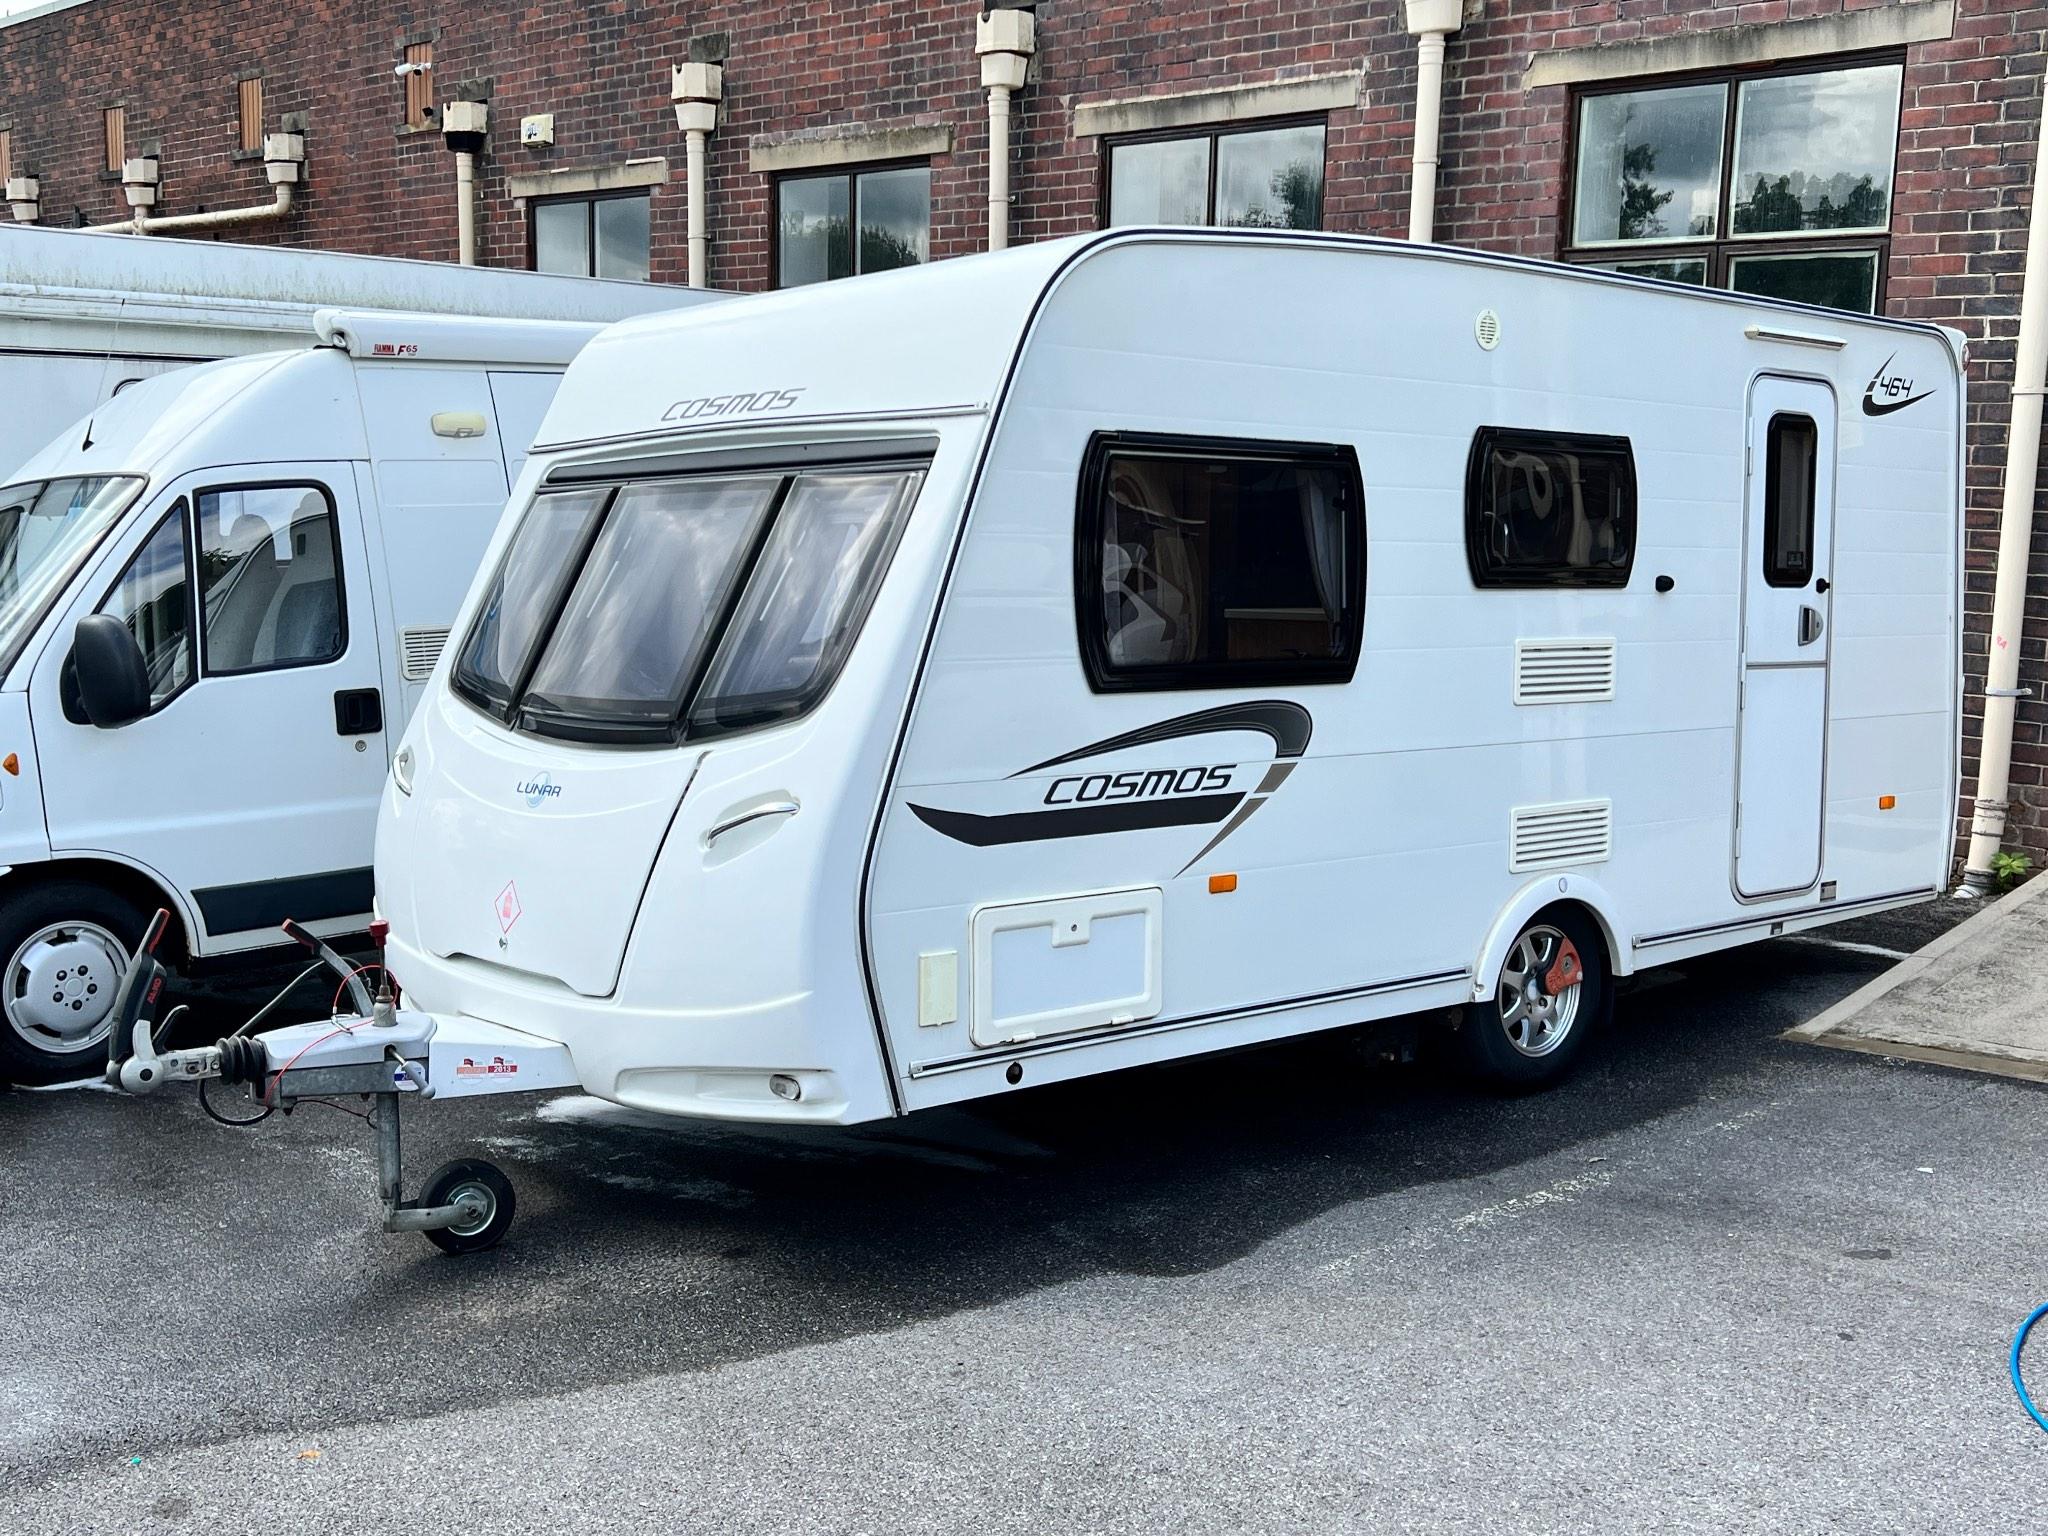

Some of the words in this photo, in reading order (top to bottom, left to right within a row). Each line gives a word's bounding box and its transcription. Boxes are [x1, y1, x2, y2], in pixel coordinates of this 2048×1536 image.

[1880, 376, 1913, 398] 464
[660, 387, 807, 421] COSMOS
[516, 781, 562, 797] LUNAR
[1043, 764, 1238, 805] COSMOS
